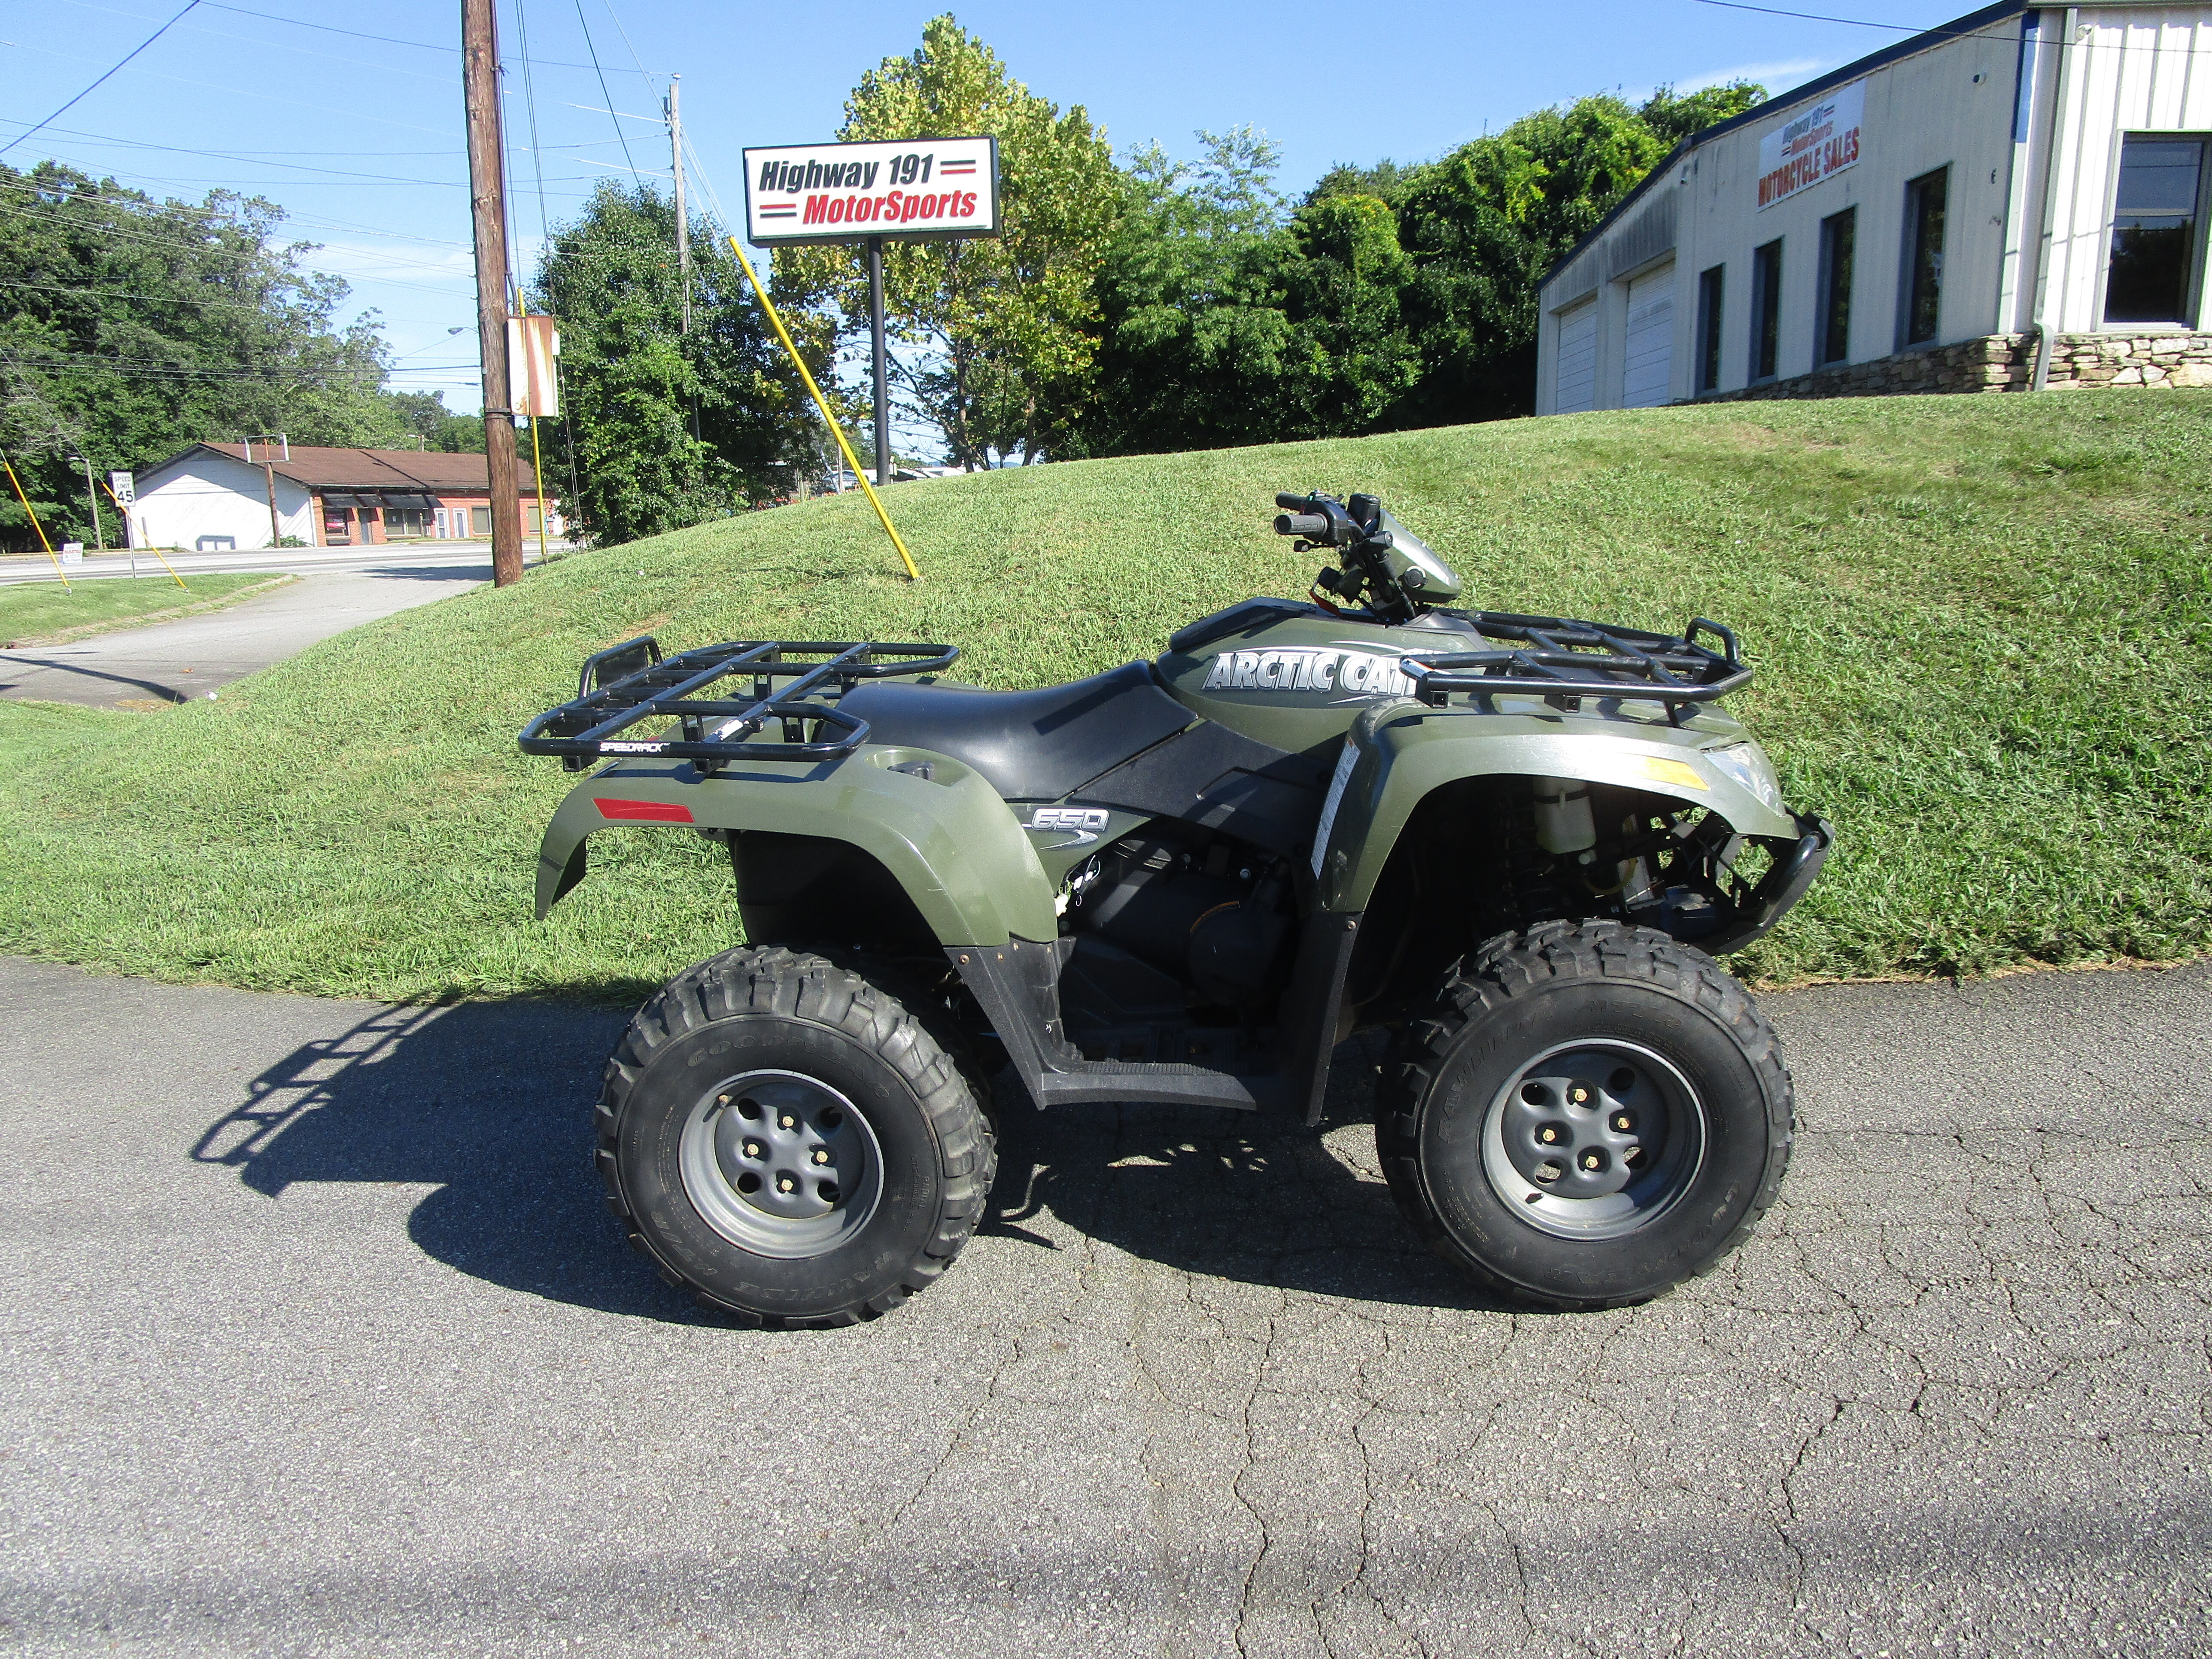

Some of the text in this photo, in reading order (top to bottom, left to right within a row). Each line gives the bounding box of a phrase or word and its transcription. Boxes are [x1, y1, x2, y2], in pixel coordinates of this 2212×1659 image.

[1811, 106, 1824, 128] 191
[759, 153, 933, 194] Highway 191
[1758, 126, 1860, 208] MOTORCYCLE SALES
[803, 190, 977, 224] MotorSports
[117, 491, 133, 502] 45
[1200, 650, 1340, 692] ARCTIC
[1340, 653, 1416, 697] CAT
[600, 742, 662, 752] SPEEDRACK
[1031, 808, 1109, 832] 650
[687, 1035, 890, 1099] GOODYEAR
